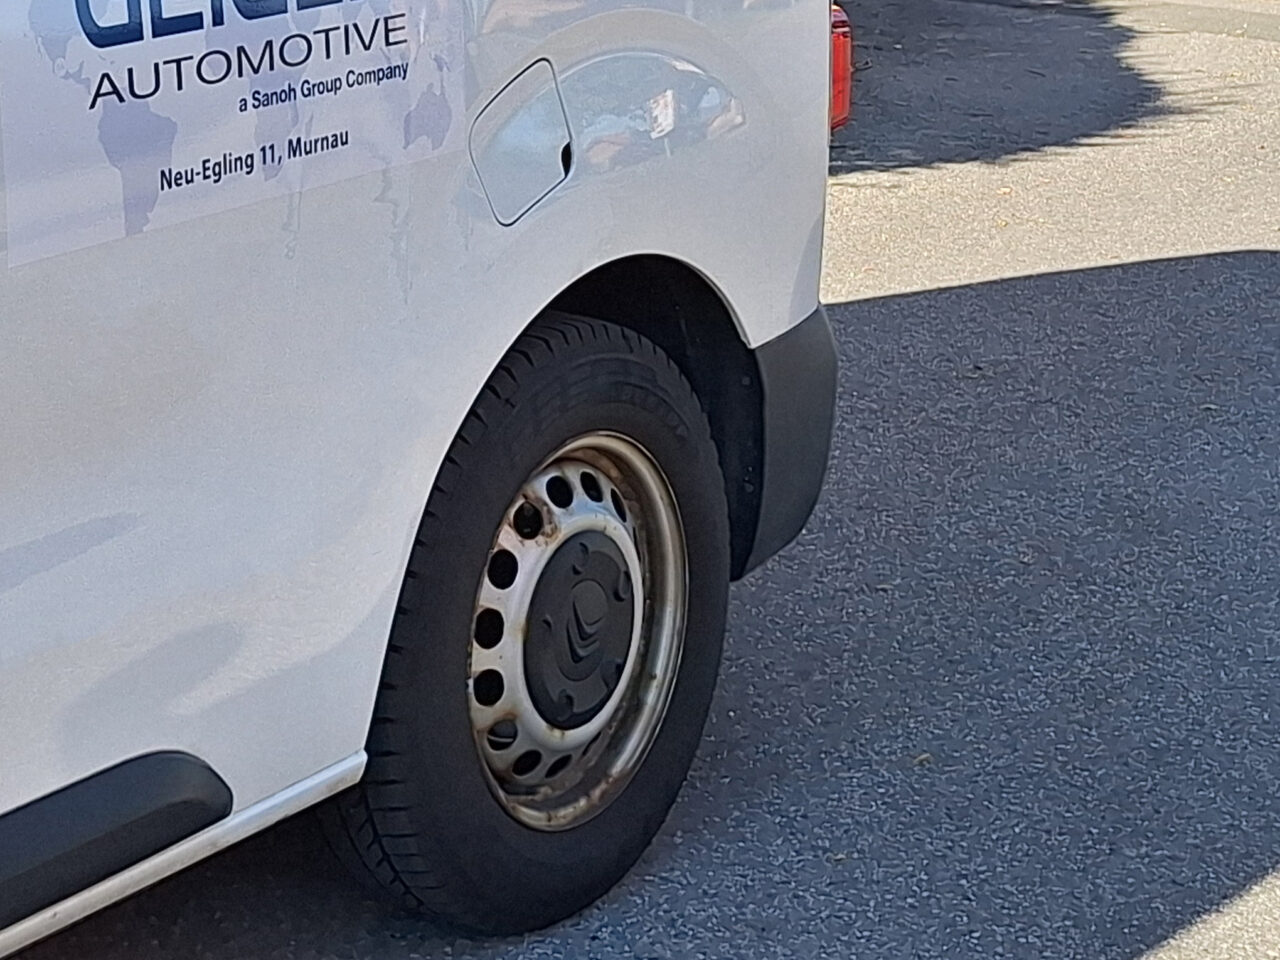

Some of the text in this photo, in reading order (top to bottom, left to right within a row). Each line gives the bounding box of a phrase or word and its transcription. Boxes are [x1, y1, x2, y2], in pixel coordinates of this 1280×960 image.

[88, 13, 409, 111] AUTOMOTIVE
[238, 62, 410, 113] a Sanoh Group Company
[159, 129, 350, 192] Neu-Egling 11, Murnau
